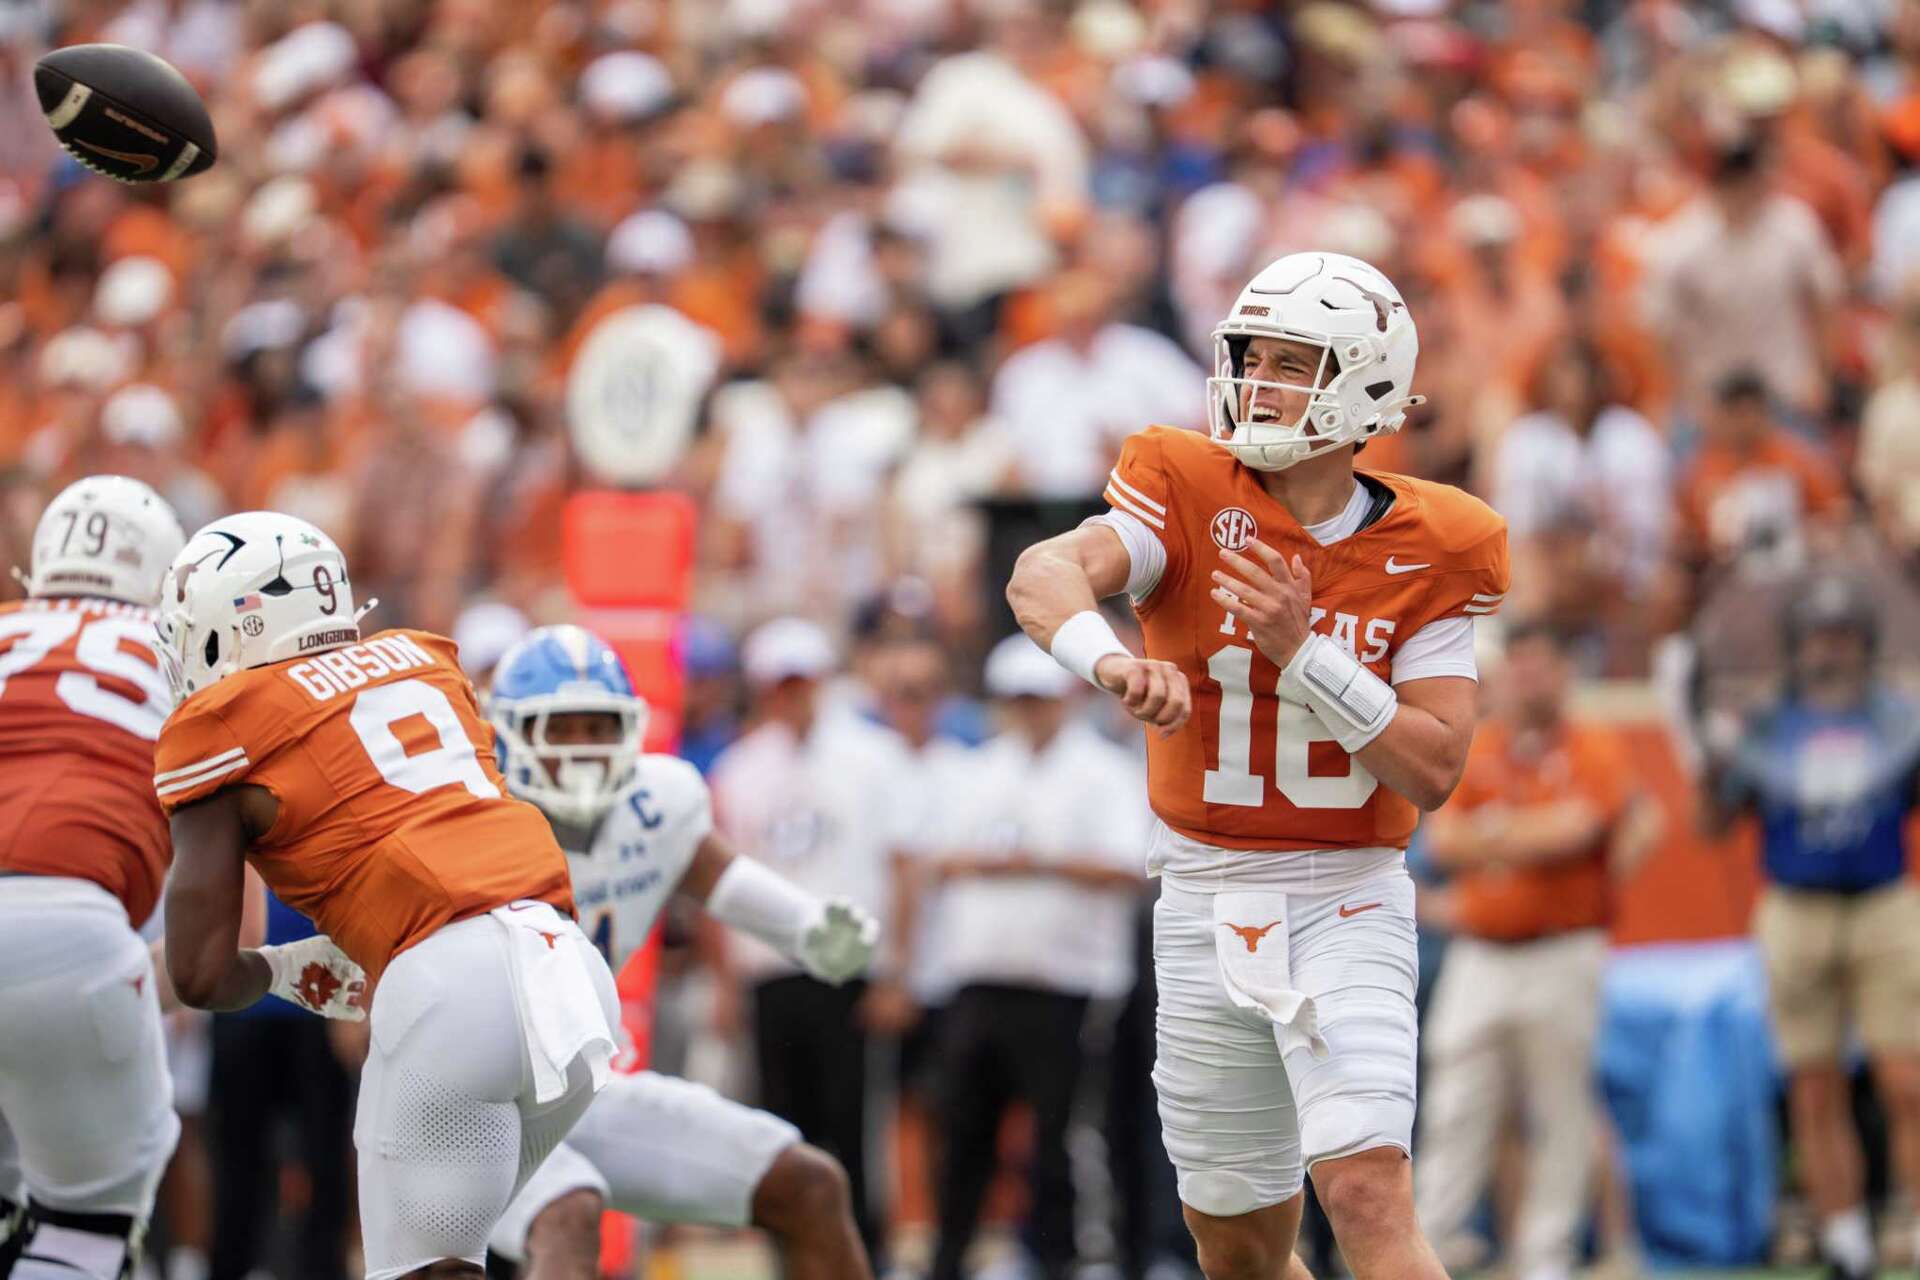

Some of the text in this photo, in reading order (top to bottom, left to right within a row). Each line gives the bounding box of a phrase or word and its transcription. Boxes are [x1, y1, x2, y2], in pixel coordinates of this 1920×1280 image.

[60, 510, 109, 558] 79
[1214, 509, 1254, 550] SEC
[313, 565, 337, 615] 9
[243, 615, 264, 636] SEC
[287, 633, 437, 701] GIBSON
[349, 678, 501, 799] 9
[1202, 644, 1378, 809] 16
[629, 790, 664, 829] C
